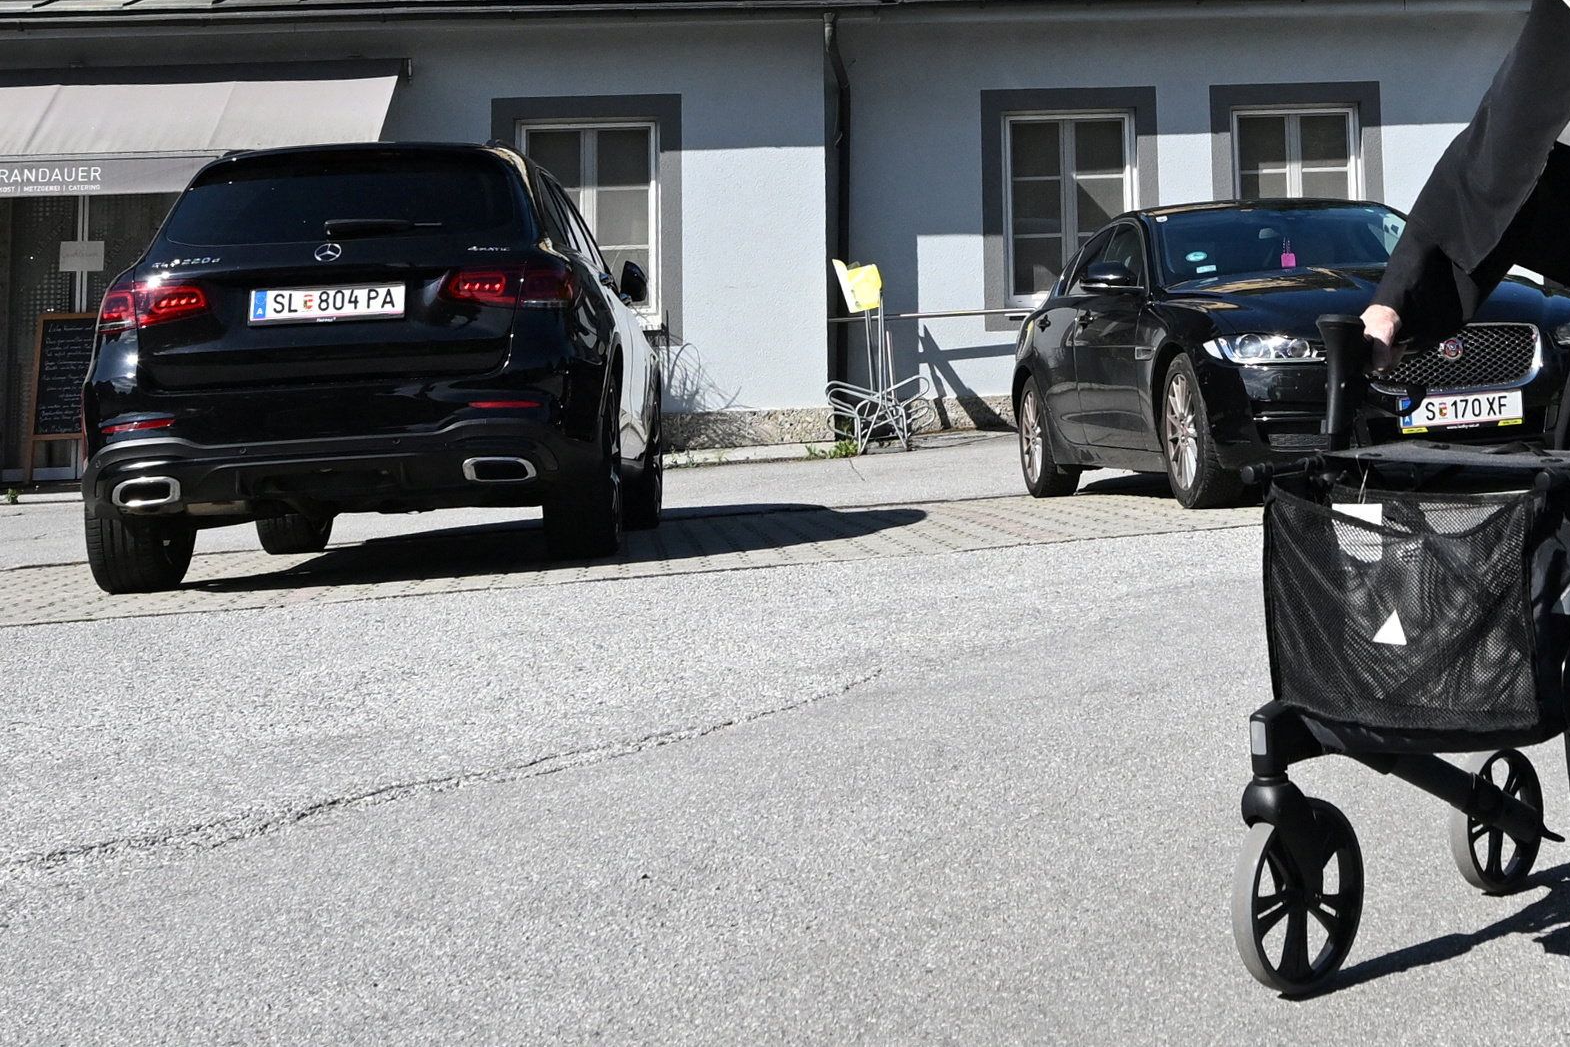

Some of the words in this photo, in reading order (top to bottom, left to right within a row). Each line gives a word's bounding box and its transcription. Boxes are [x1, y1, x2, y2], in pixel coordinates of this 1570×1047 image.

[273, 293, 298, 314] SL
[318, 289, 359, 311] 804
[366, 288, 395, 309] PA
[1425, 401, 1436, 421] S
[1450, 398, 1482, 420] 170
[1486, 395, 1507, 416] XF
